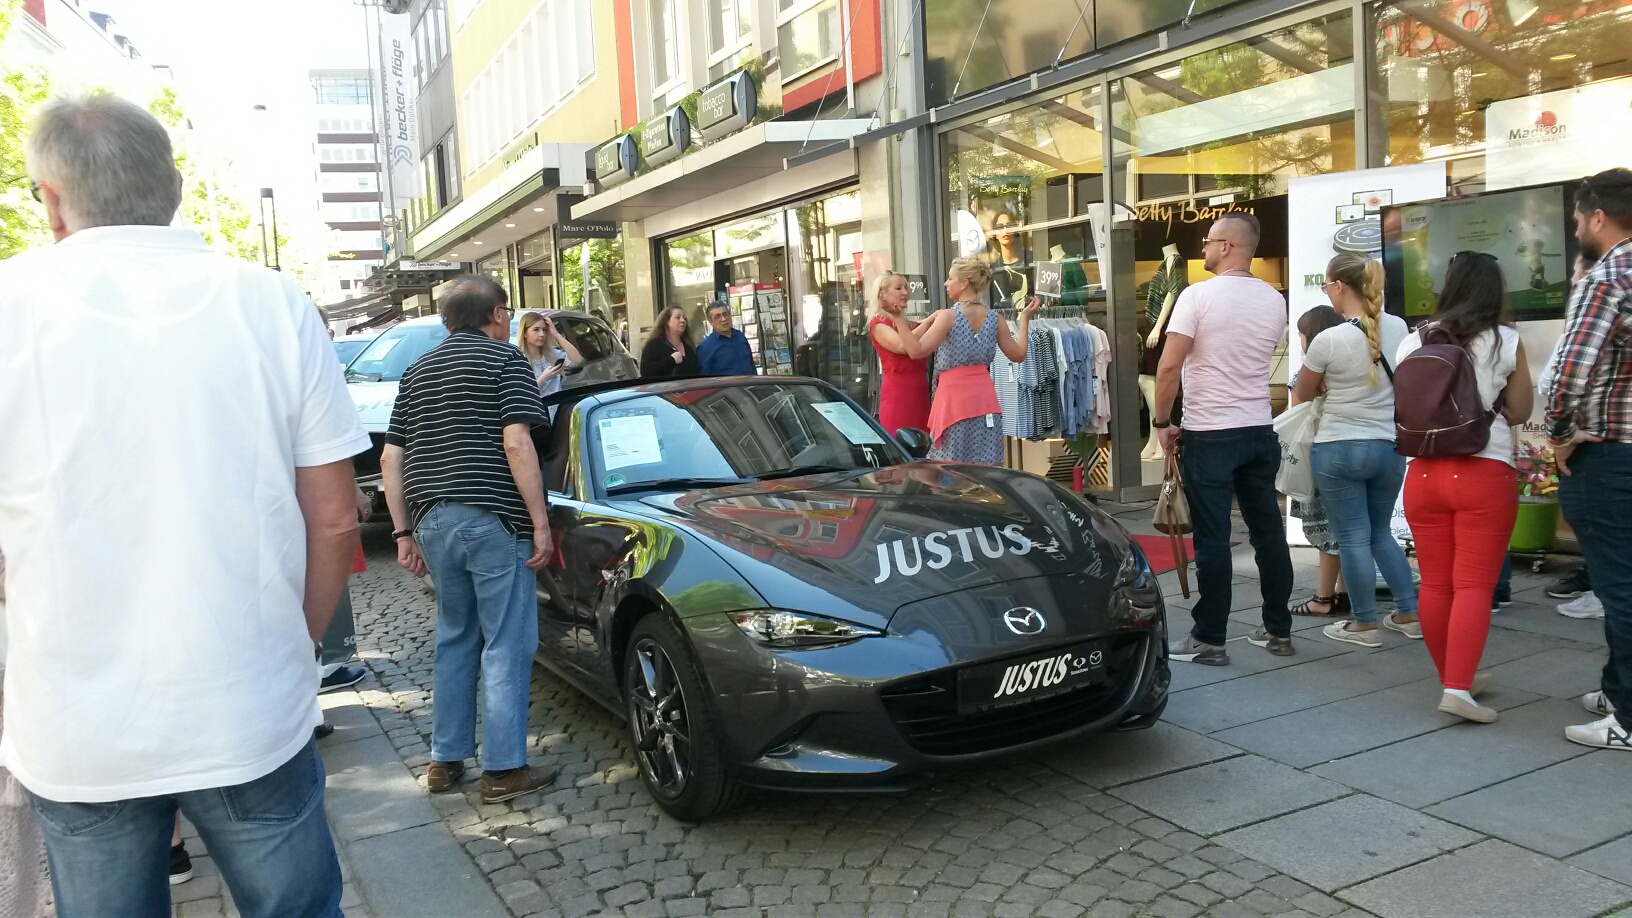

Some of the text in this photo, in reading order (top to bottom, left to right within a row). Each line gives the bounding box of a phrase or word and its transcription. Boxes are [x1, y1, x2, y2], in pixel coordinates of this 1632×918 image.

[392, 39, 405, 78] flöge
[395, 87, 408, 141] becker
[702, 92, 726, 112] tobacco
[713, 104, 724, 118] bar
[1508, 124, 1566, 141] Madison
[1135, 200, 1172, 239] etty
[874, 523, 1032, 584] JUSTUS
[993, 653, 1072, 698] JUSTUS
